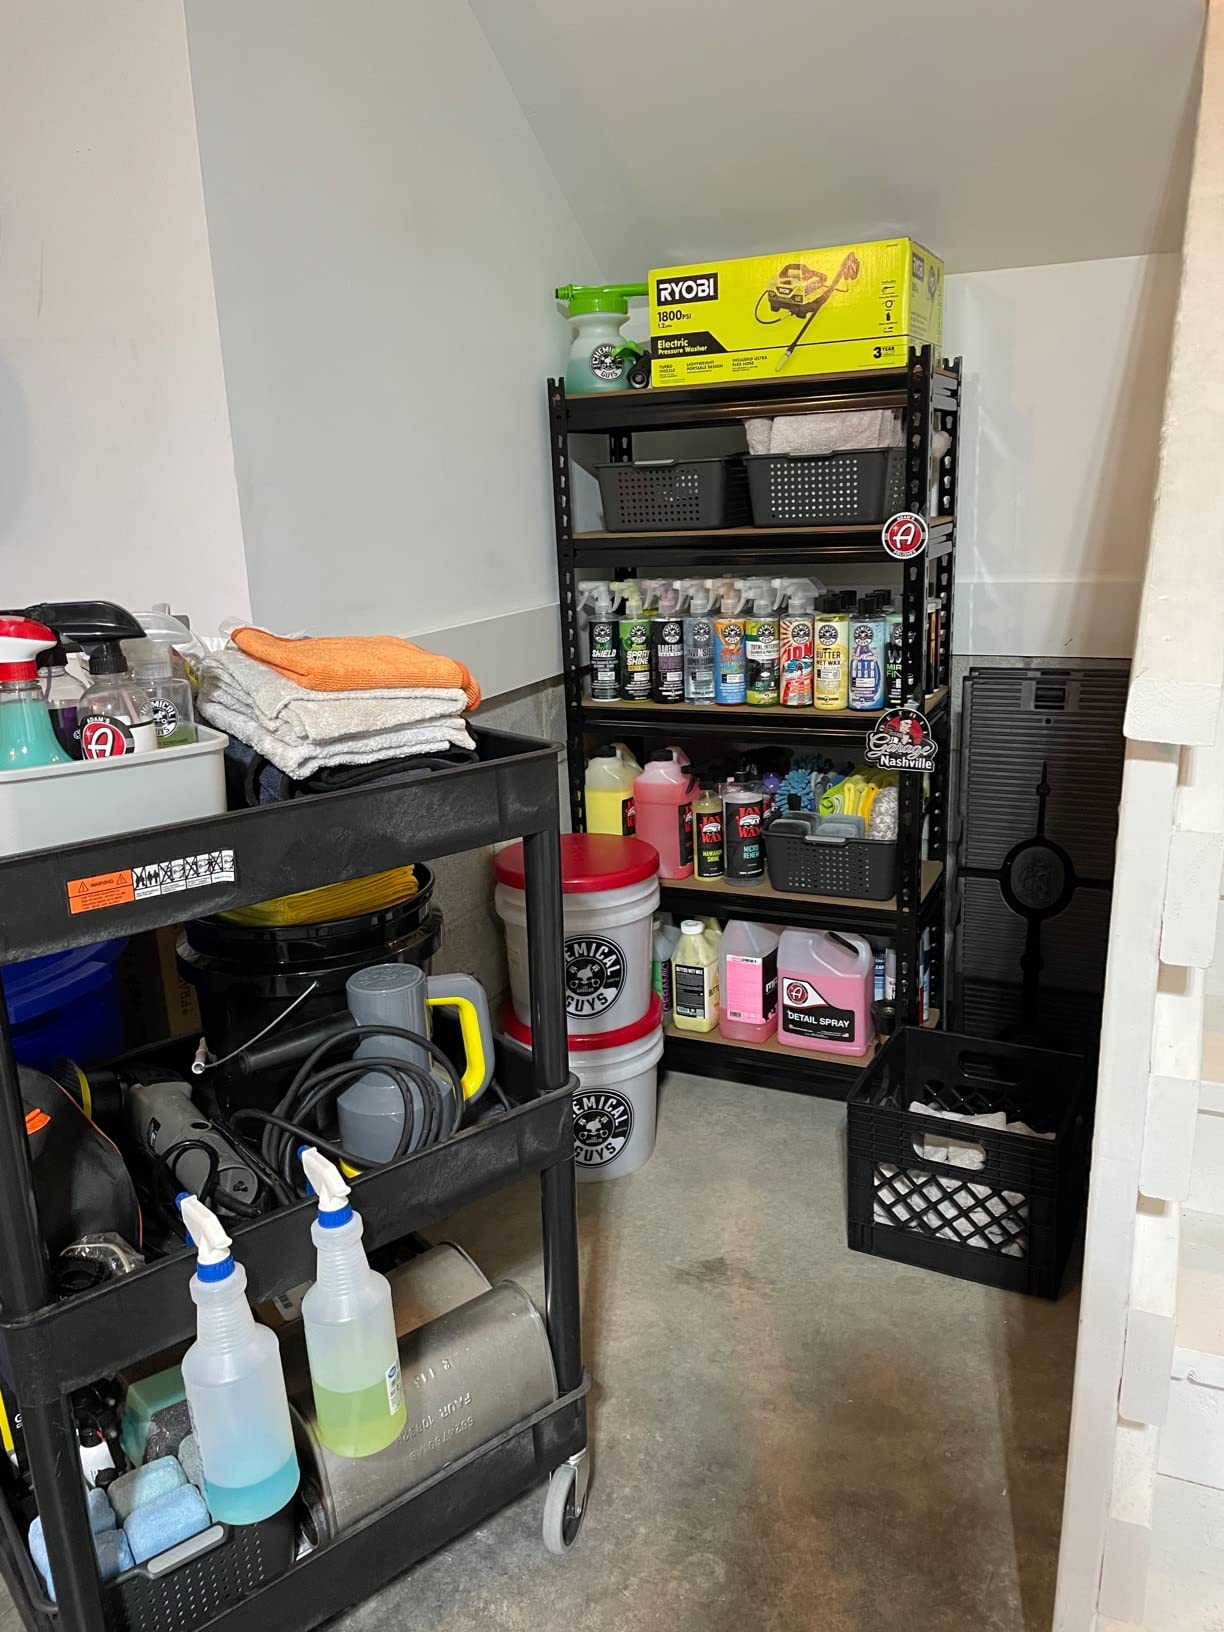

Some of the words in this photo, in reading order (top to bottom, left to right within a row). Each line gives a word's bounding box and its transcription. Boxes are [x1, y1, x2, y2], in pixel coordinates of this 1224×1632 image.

[659, 278, 715, 302] RYOBI
[657, 337, 689, 349] Electric
[658, 347, 684, 356] Pressure
[685, 345, 708, 354] Washer
[873, 346, 882, 359] 3
[600, 370, 618, 378] GUYS
[591, 649, 617, 658] SHIELD
[626, 650, 650, 659] SPRAY
[816, 650, 841, 659] BUTTER
[626, 657, 649, 666] SHINE
[886, 663, 903, 671] MIR
[886, 670, 902, 678] FIN
[867, 733, 935, 760] Garage
[880, 755, 932, 769] Nashville
[90, 879, 114, 888] WARNING
[564, 942, 620, 976] EMICAL
[661, 961, 670, 1010] CERAMIC
[788, 1010, 818, 1025] DETAIL
[819, 1017, 850, 1028] SPRAY
[573, 1095, 629, 1127] EMICAL
